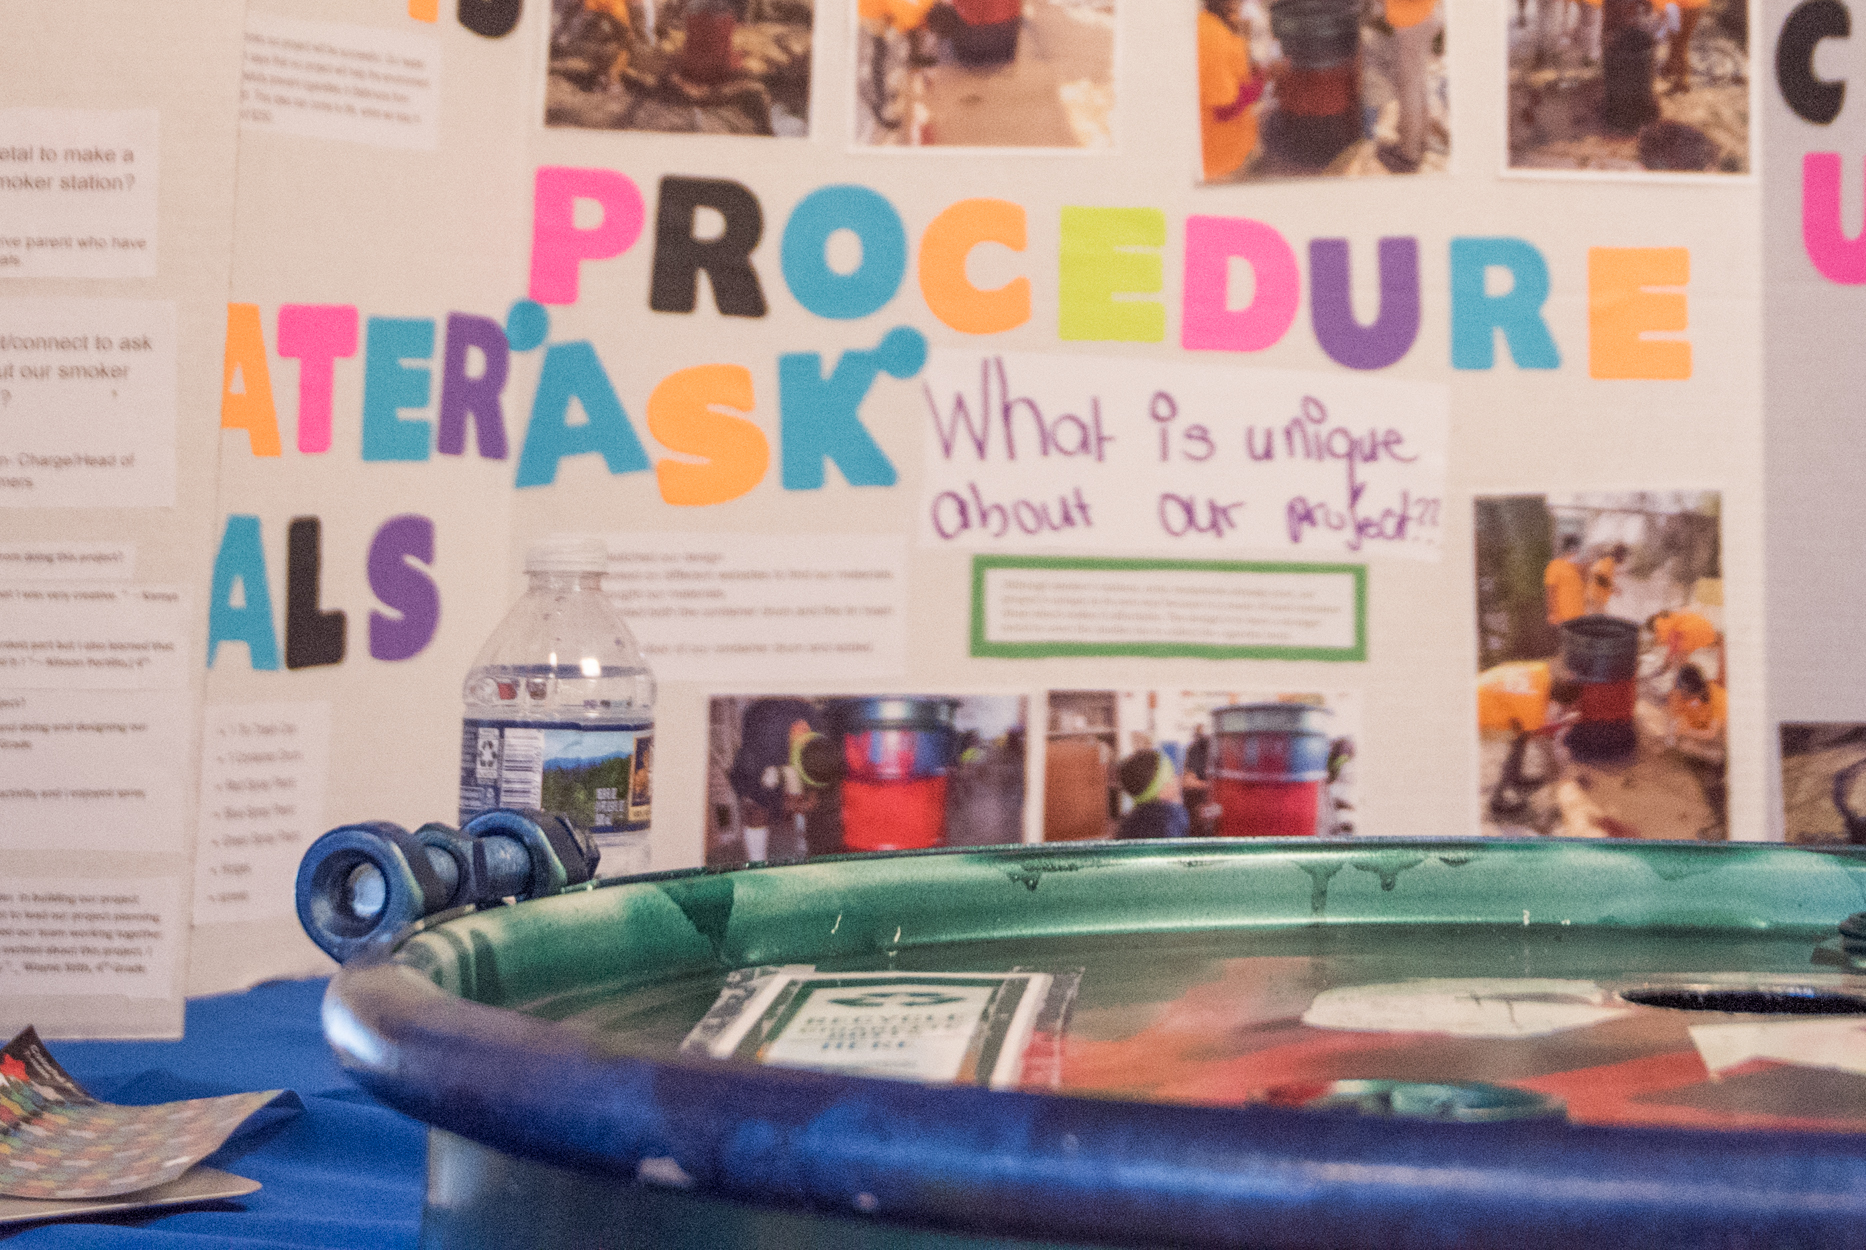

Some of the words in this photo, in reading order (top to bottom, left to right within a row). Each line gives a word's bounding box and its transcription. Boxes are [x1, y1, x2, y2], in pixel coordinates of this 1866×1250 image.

[39, 147, 58, 163] to
[63, 147, 117, 163] make
[527, 164, 1692, 381] PROCEDURE
[57, 362, 130, 380] smoker
[95, 334, 114, 351] to
[118, 334, 153, 351] ask
[924, 356, 1116, 463] What
[1149, 389, 1217, 463] is
[1246, 394, 1418, 490] unique
[932, 482, 1094, 539] about
[1158, 491, 1246, 538] our
[207, 513, 443, 673] ALS
